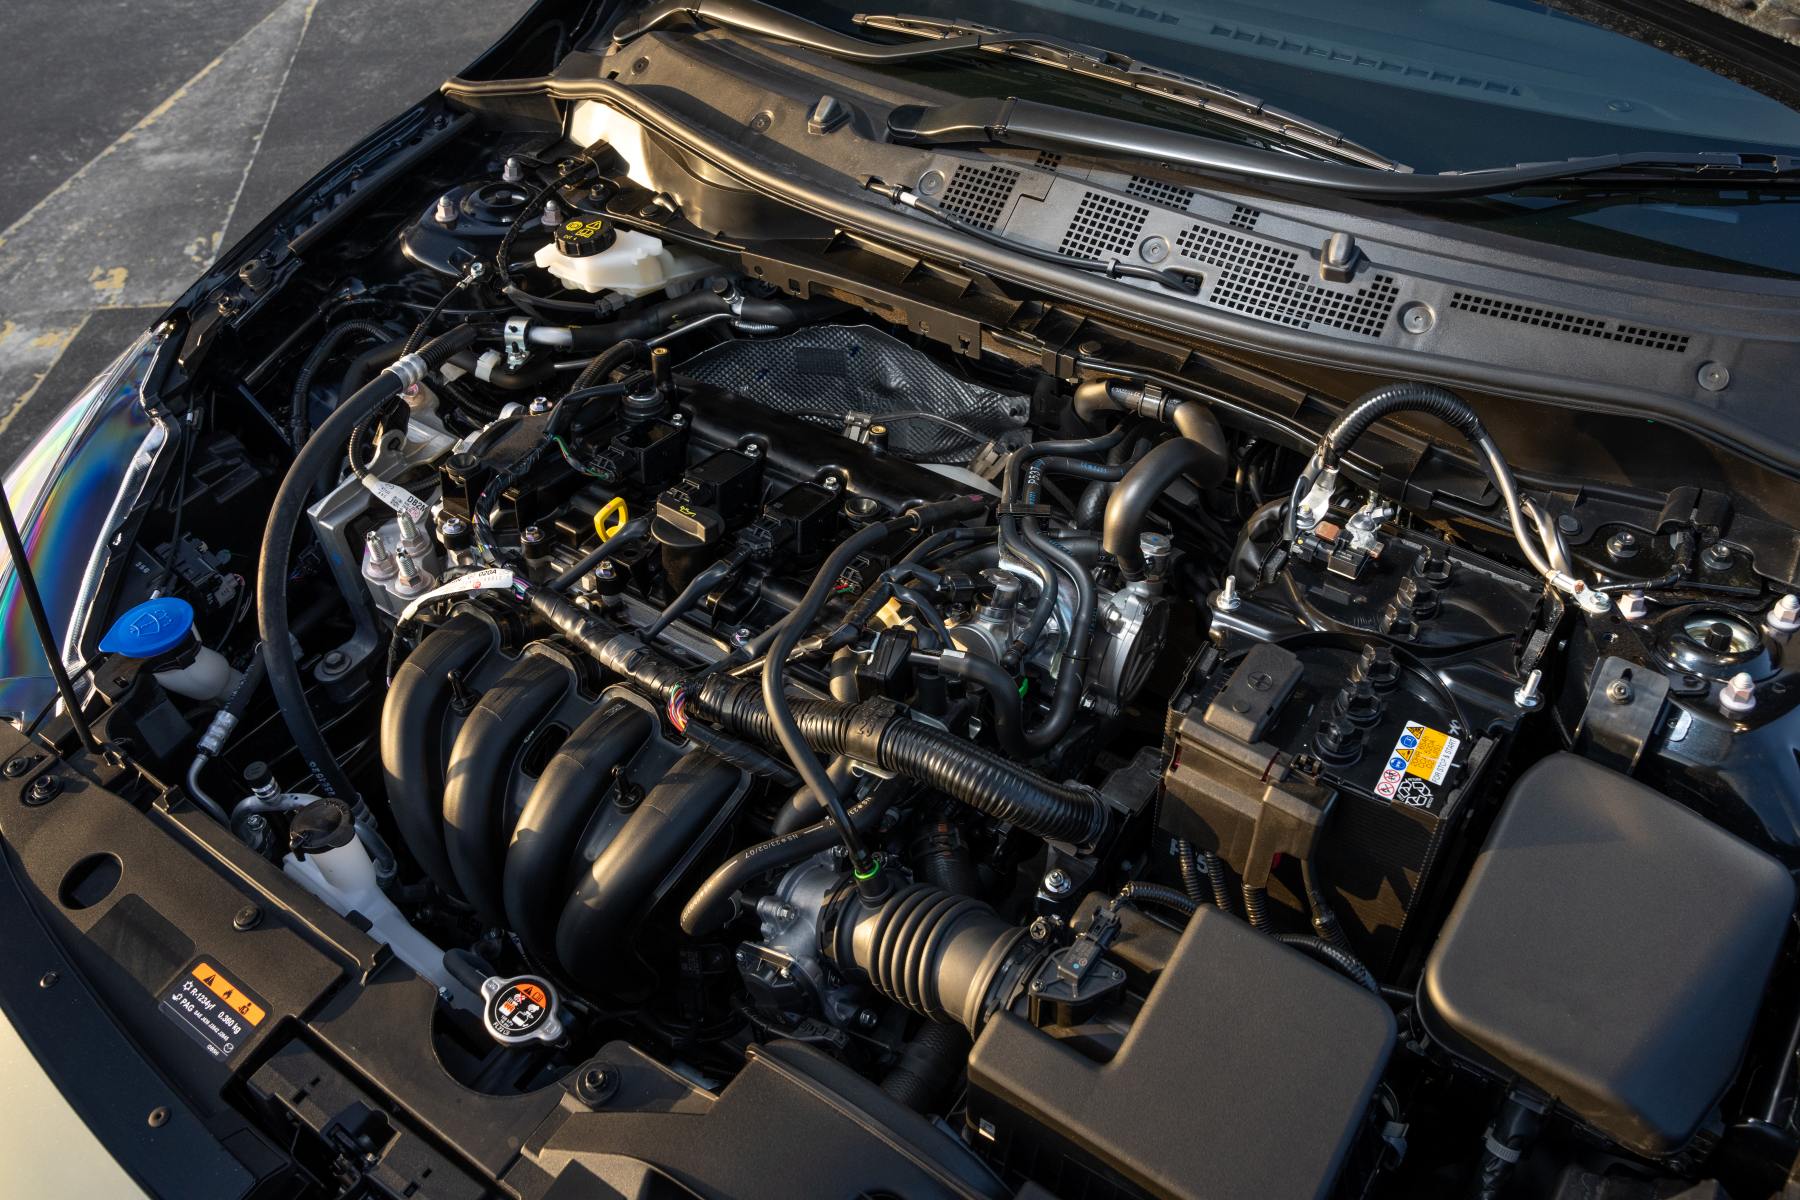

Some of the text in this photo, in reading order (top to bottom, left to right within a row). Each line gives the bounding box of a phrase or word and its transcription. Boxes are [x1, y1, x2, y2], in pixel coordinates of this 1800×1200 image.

[1446, 738, 1456, 754] START
[180, 999, 195, 1012] PAG
[190, 987, 216, 1010] R-1234yf
[232, 1023, 241, 1034] kg
